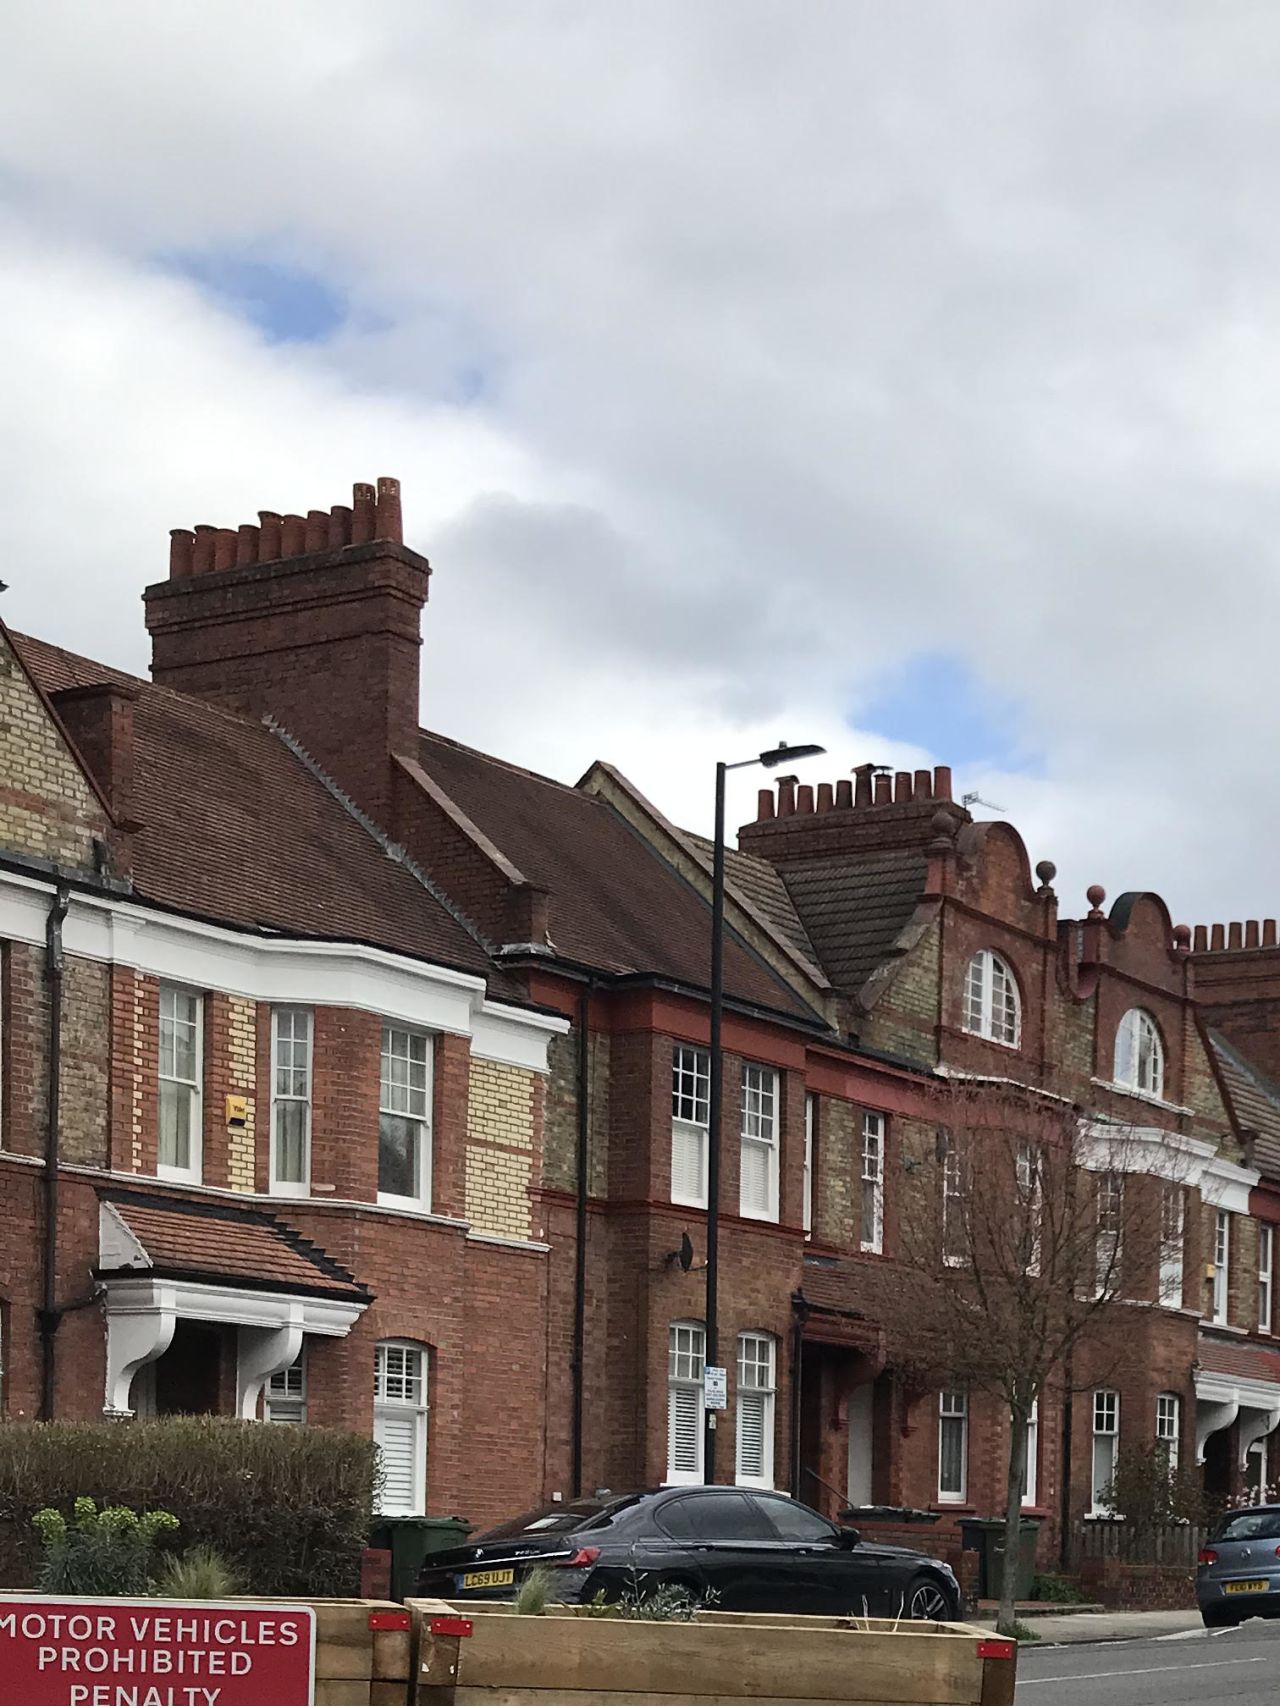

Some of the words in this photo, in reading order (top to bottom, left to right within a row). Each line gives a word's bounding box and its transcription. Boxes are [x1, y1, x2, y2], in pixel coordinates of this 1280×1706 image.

[465, 1573, 489, 1587] LC69
[492, 1570, 512, 1583] UJT
[0, 1613, 116, 1641] MOTOR
[129, 1616, 298, 1646] VEHICLES
[38, 1646, 252, 1675] PROHIBITED
